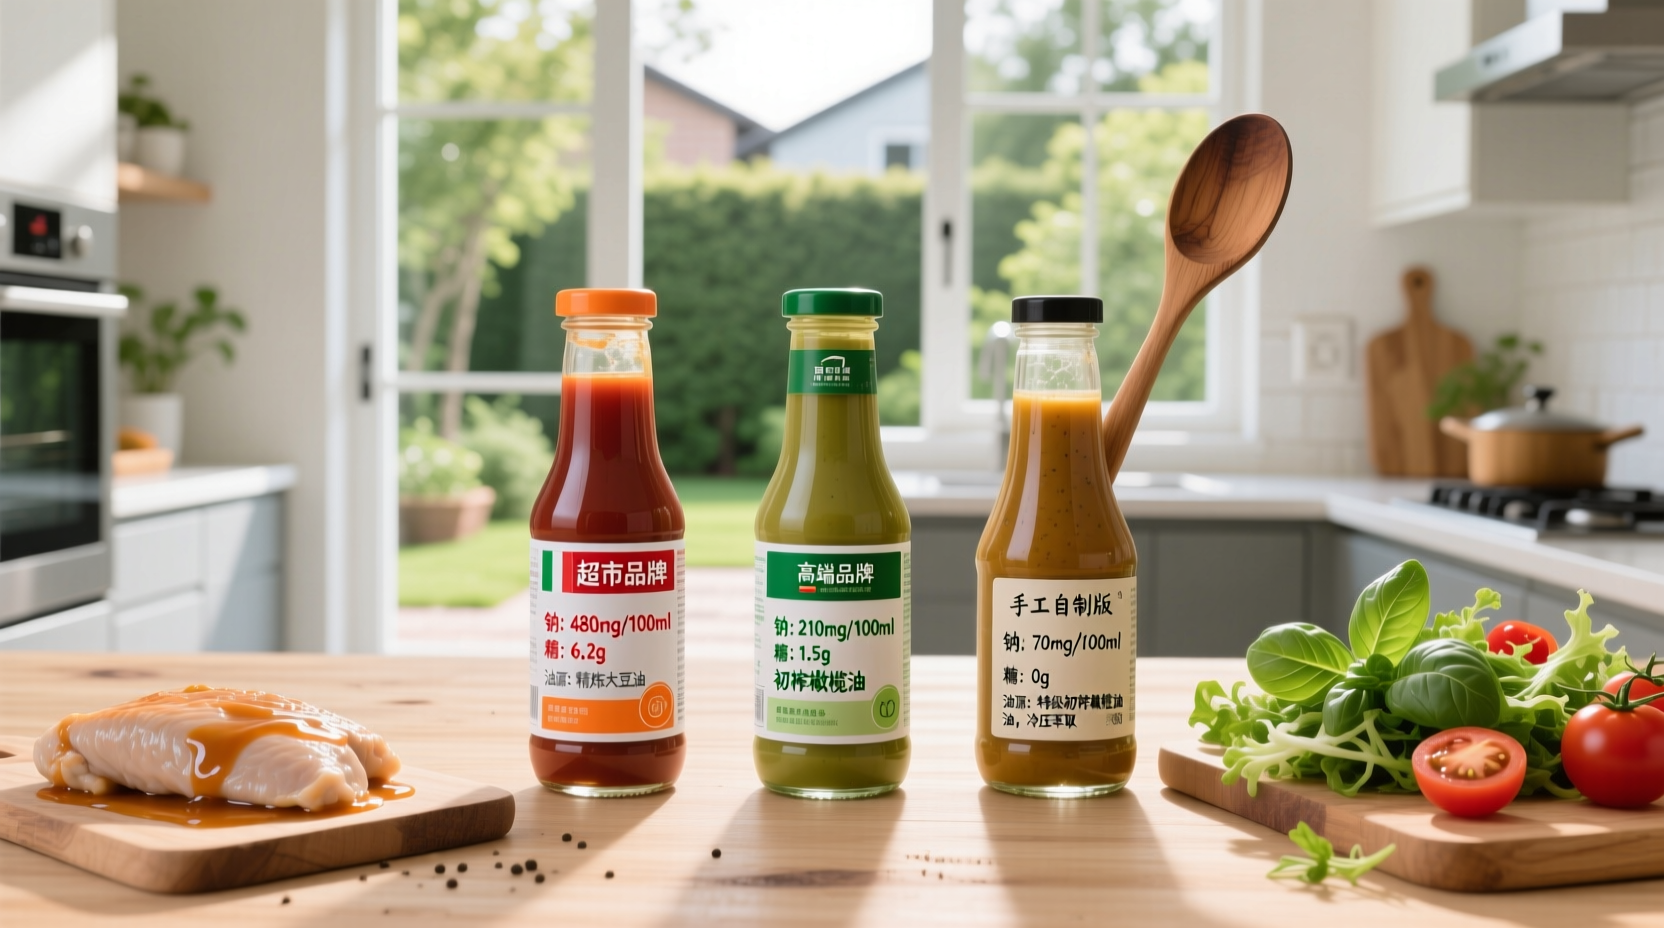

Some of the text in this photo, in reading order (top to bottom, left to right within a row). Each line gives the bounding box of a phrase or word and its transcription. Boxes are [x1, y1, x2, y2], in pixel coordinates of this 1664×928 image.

[576, 559, 668, 587] 超市品牌
[797, 562, 875, 584] 高端品牌
[1009, 593, 1113, 617] 手工自制版
[798, 617, 894, 642] 210mg/100ml
[570, 642, 606, 665] 6.2g
[799, 645, 831, 666] 1.5g
[1032, 631, 1121, 657] 70mg/100ml
[1031, 668, 1050, 689] 0g
